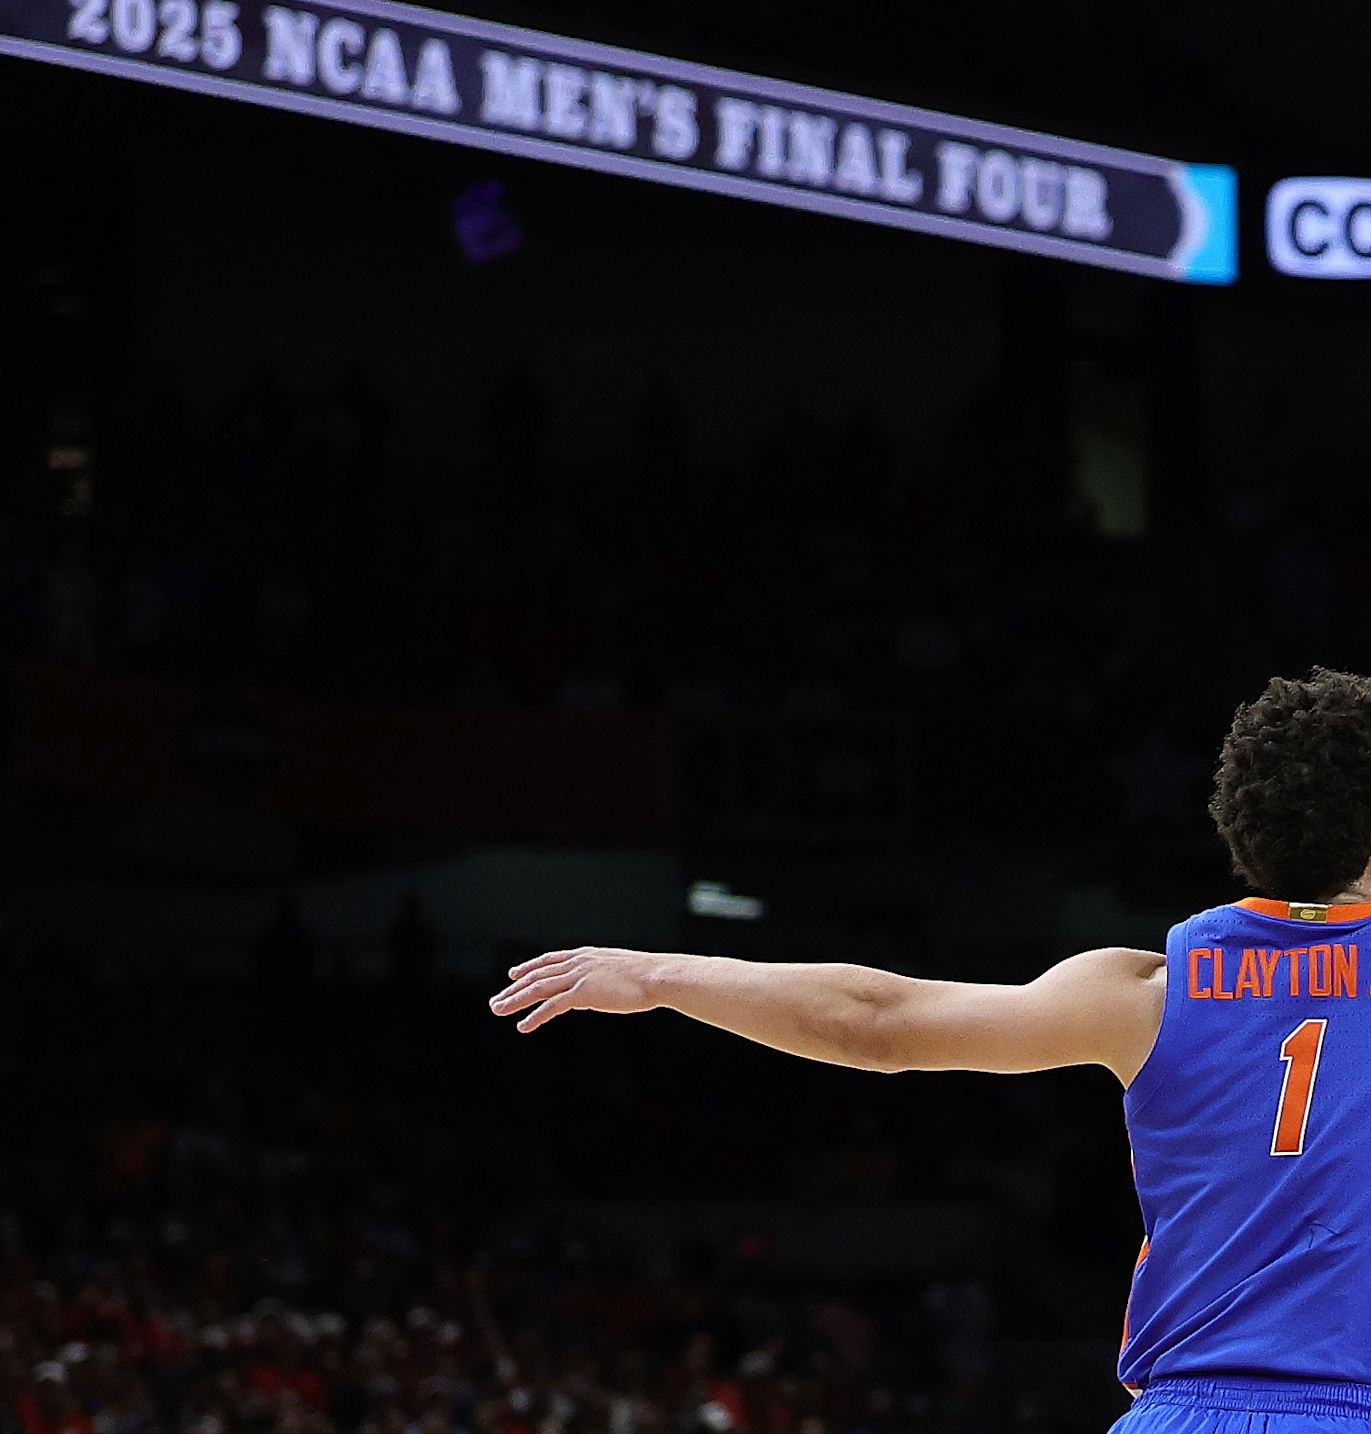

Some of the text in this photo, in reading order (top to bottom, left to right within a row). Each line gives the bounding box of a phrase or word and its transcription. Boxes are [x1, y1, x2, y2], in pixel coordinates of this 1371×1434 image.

[67, 0, 1113, 240] 2025 NCAA MEN'S FINAL FOUR
[1187, 944, 1359, 1000] CLAYTON
[1269, 1018, 1329, 1157] 1
